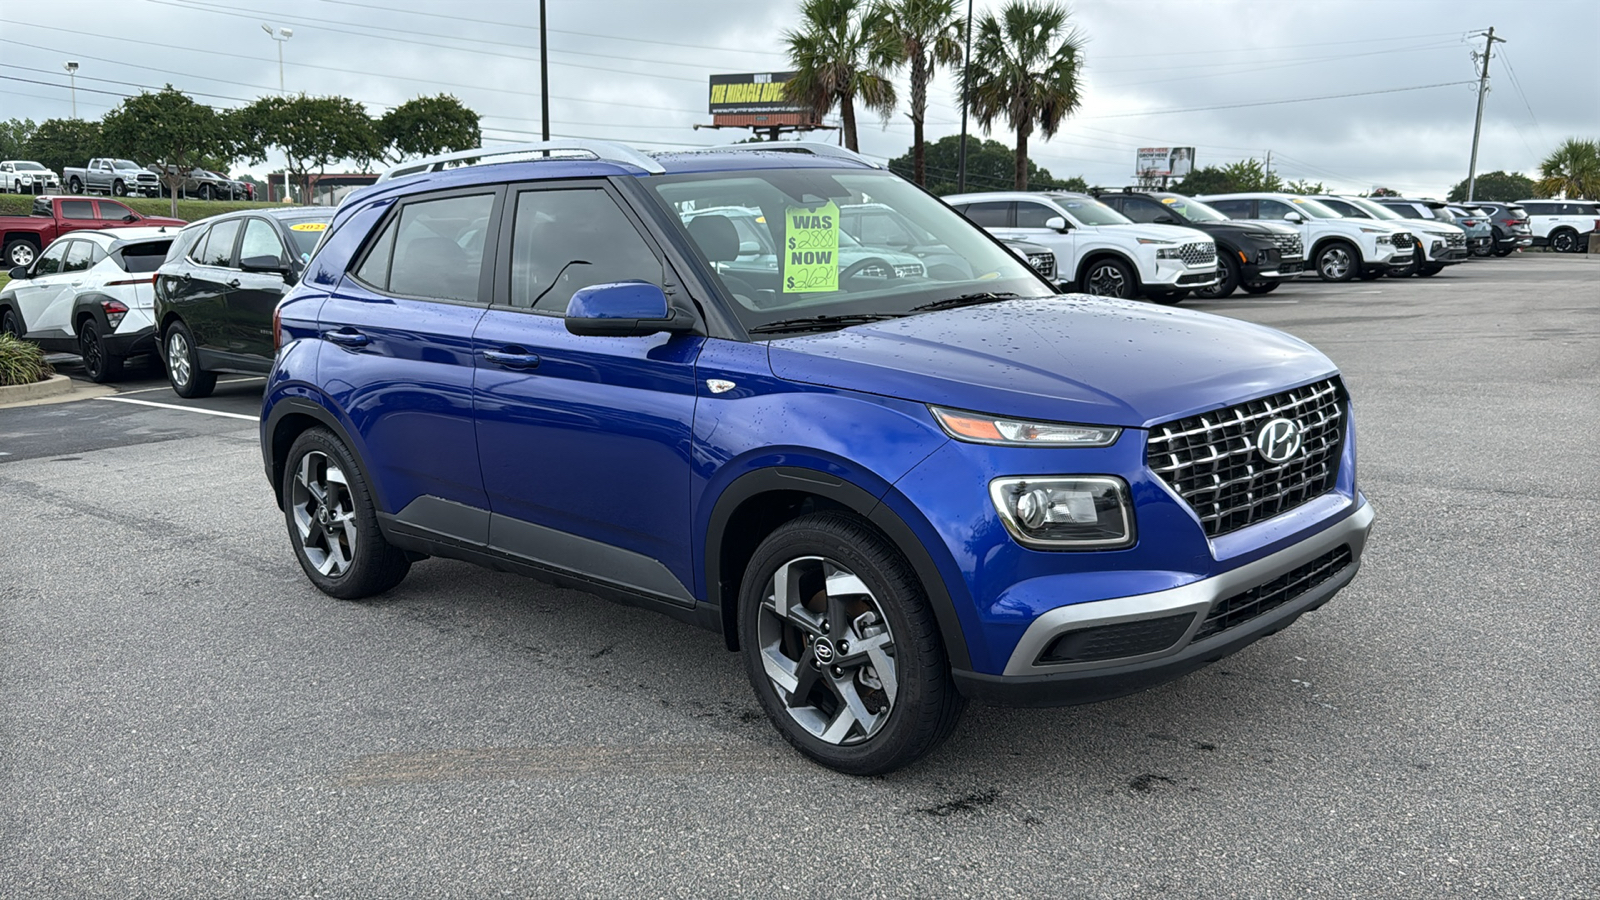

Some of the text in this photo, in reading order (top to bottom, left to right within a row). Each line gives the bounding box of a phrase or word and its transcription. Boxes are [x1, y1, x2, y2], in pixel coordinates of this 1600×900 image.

[711, 85, 727, 103] THE
[725, 83, 762, 103] MIRACLE
[792, 215, 832, 230] WAS
[791, 251, 832, 265] NOW
